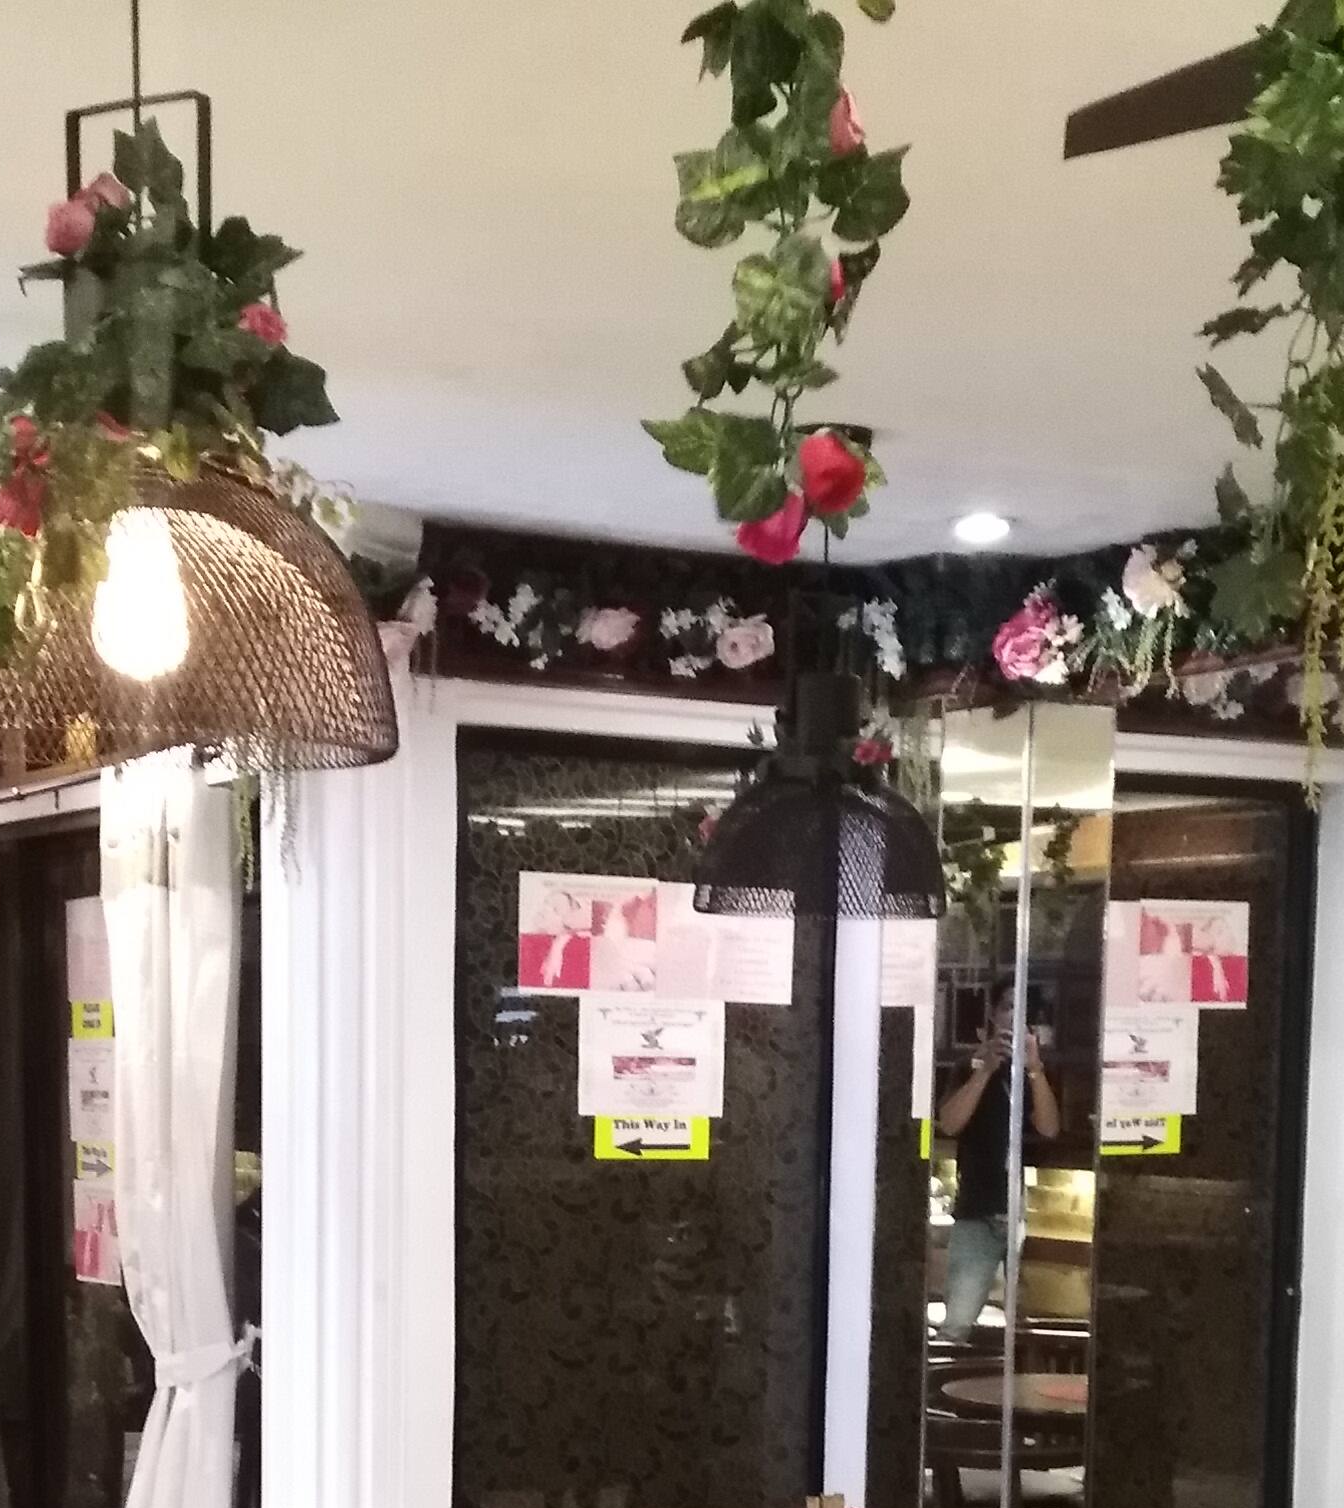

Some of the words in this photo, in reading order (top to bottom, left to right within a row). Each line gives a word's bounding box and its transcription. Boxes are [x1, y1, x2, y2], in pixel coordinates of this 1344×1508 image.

[614, 1119, 640, 1130] This
[643, 1119, 669, 1132] Way
[674, 1119, 687, 1130] In
